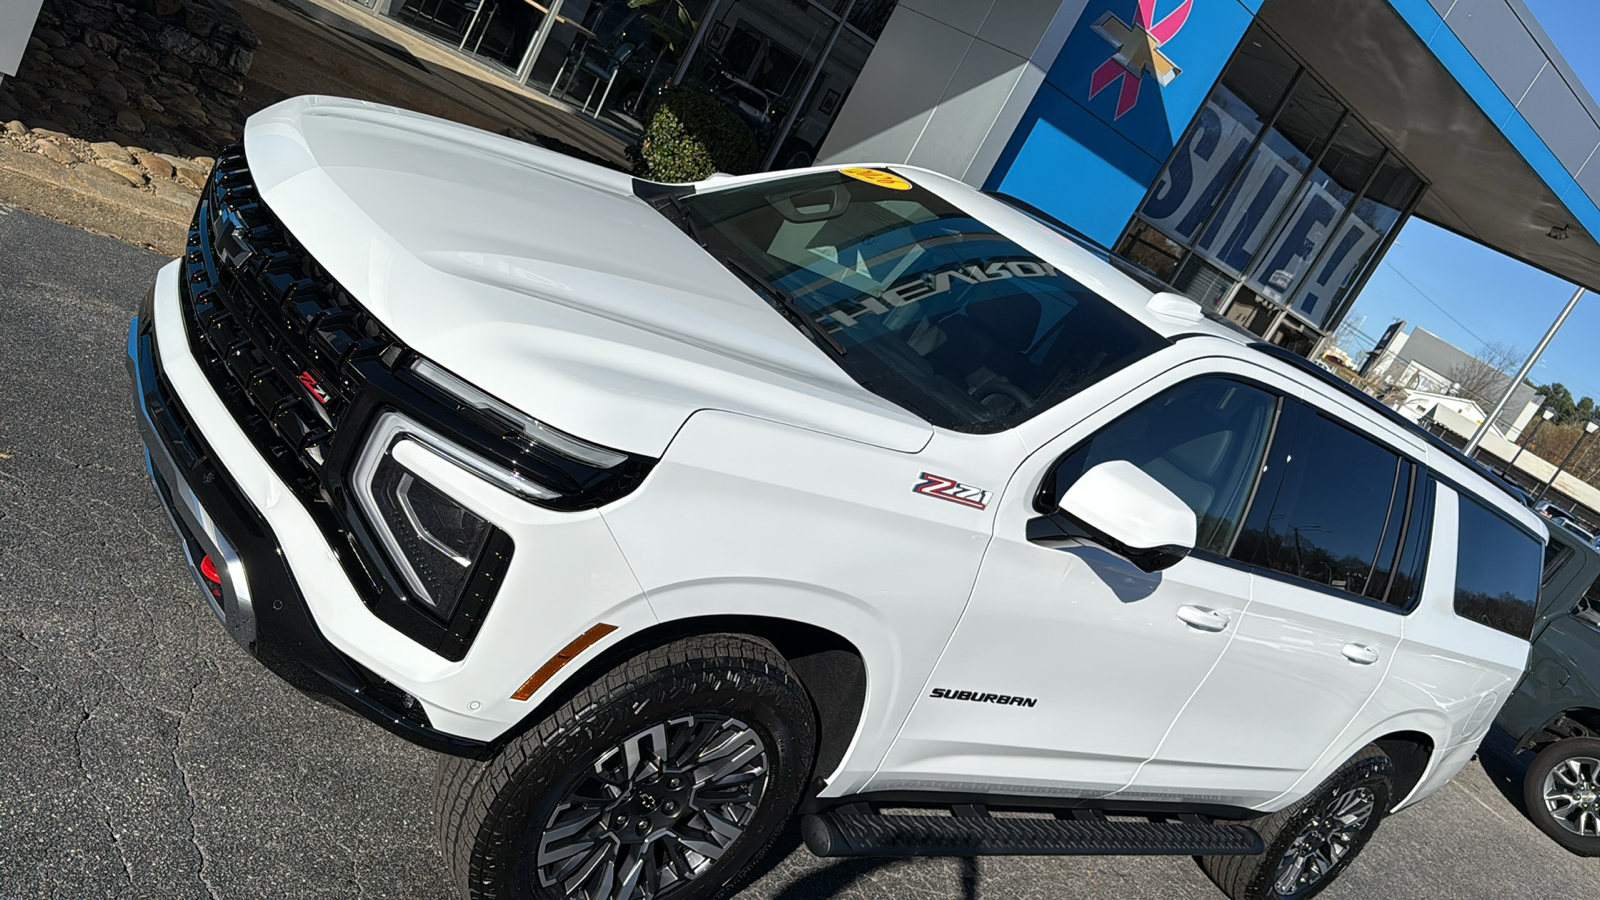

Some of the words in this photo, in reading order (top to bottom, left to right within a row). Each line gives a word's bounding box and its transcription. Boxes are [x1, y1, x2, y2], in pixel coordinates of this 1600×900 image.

[1142, 106, 1366, 315] SALE!
[299, 371, 331, 404] Z71
[912, 471, 994, 511] Z71
[929, 687, 1038, 708] SUBURBAN
